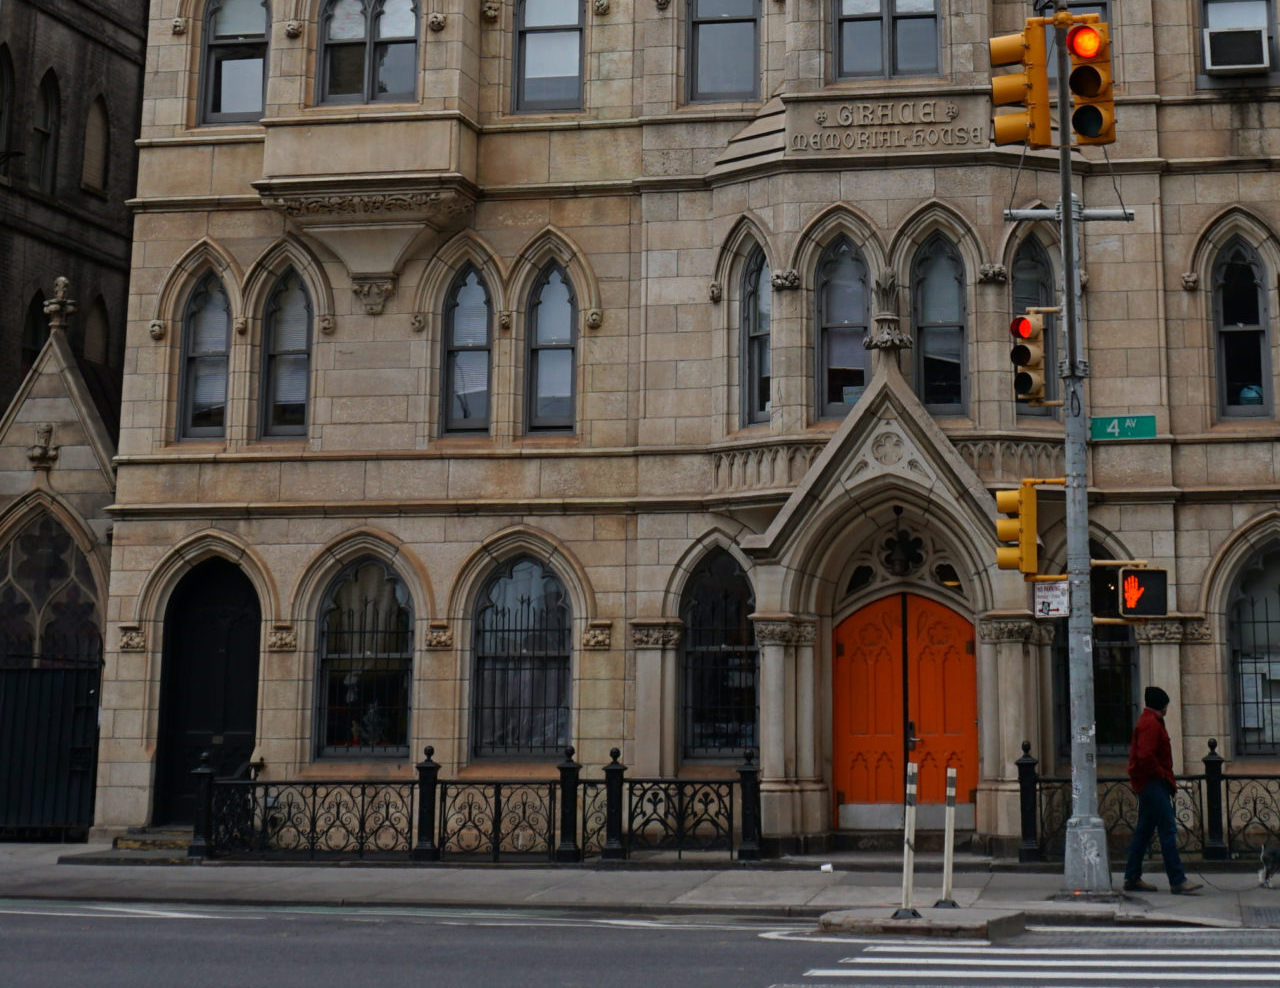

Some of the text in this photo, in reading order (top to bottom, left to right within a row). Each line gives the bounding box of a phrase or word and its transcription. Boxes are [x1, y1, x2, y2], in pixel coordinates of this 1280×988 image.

[836, 100, 936, 127] GRACE
[791, 126, 983, 151] MEMORIAL HOUSE
[1106, 418, 1137, 437] 4 AV
